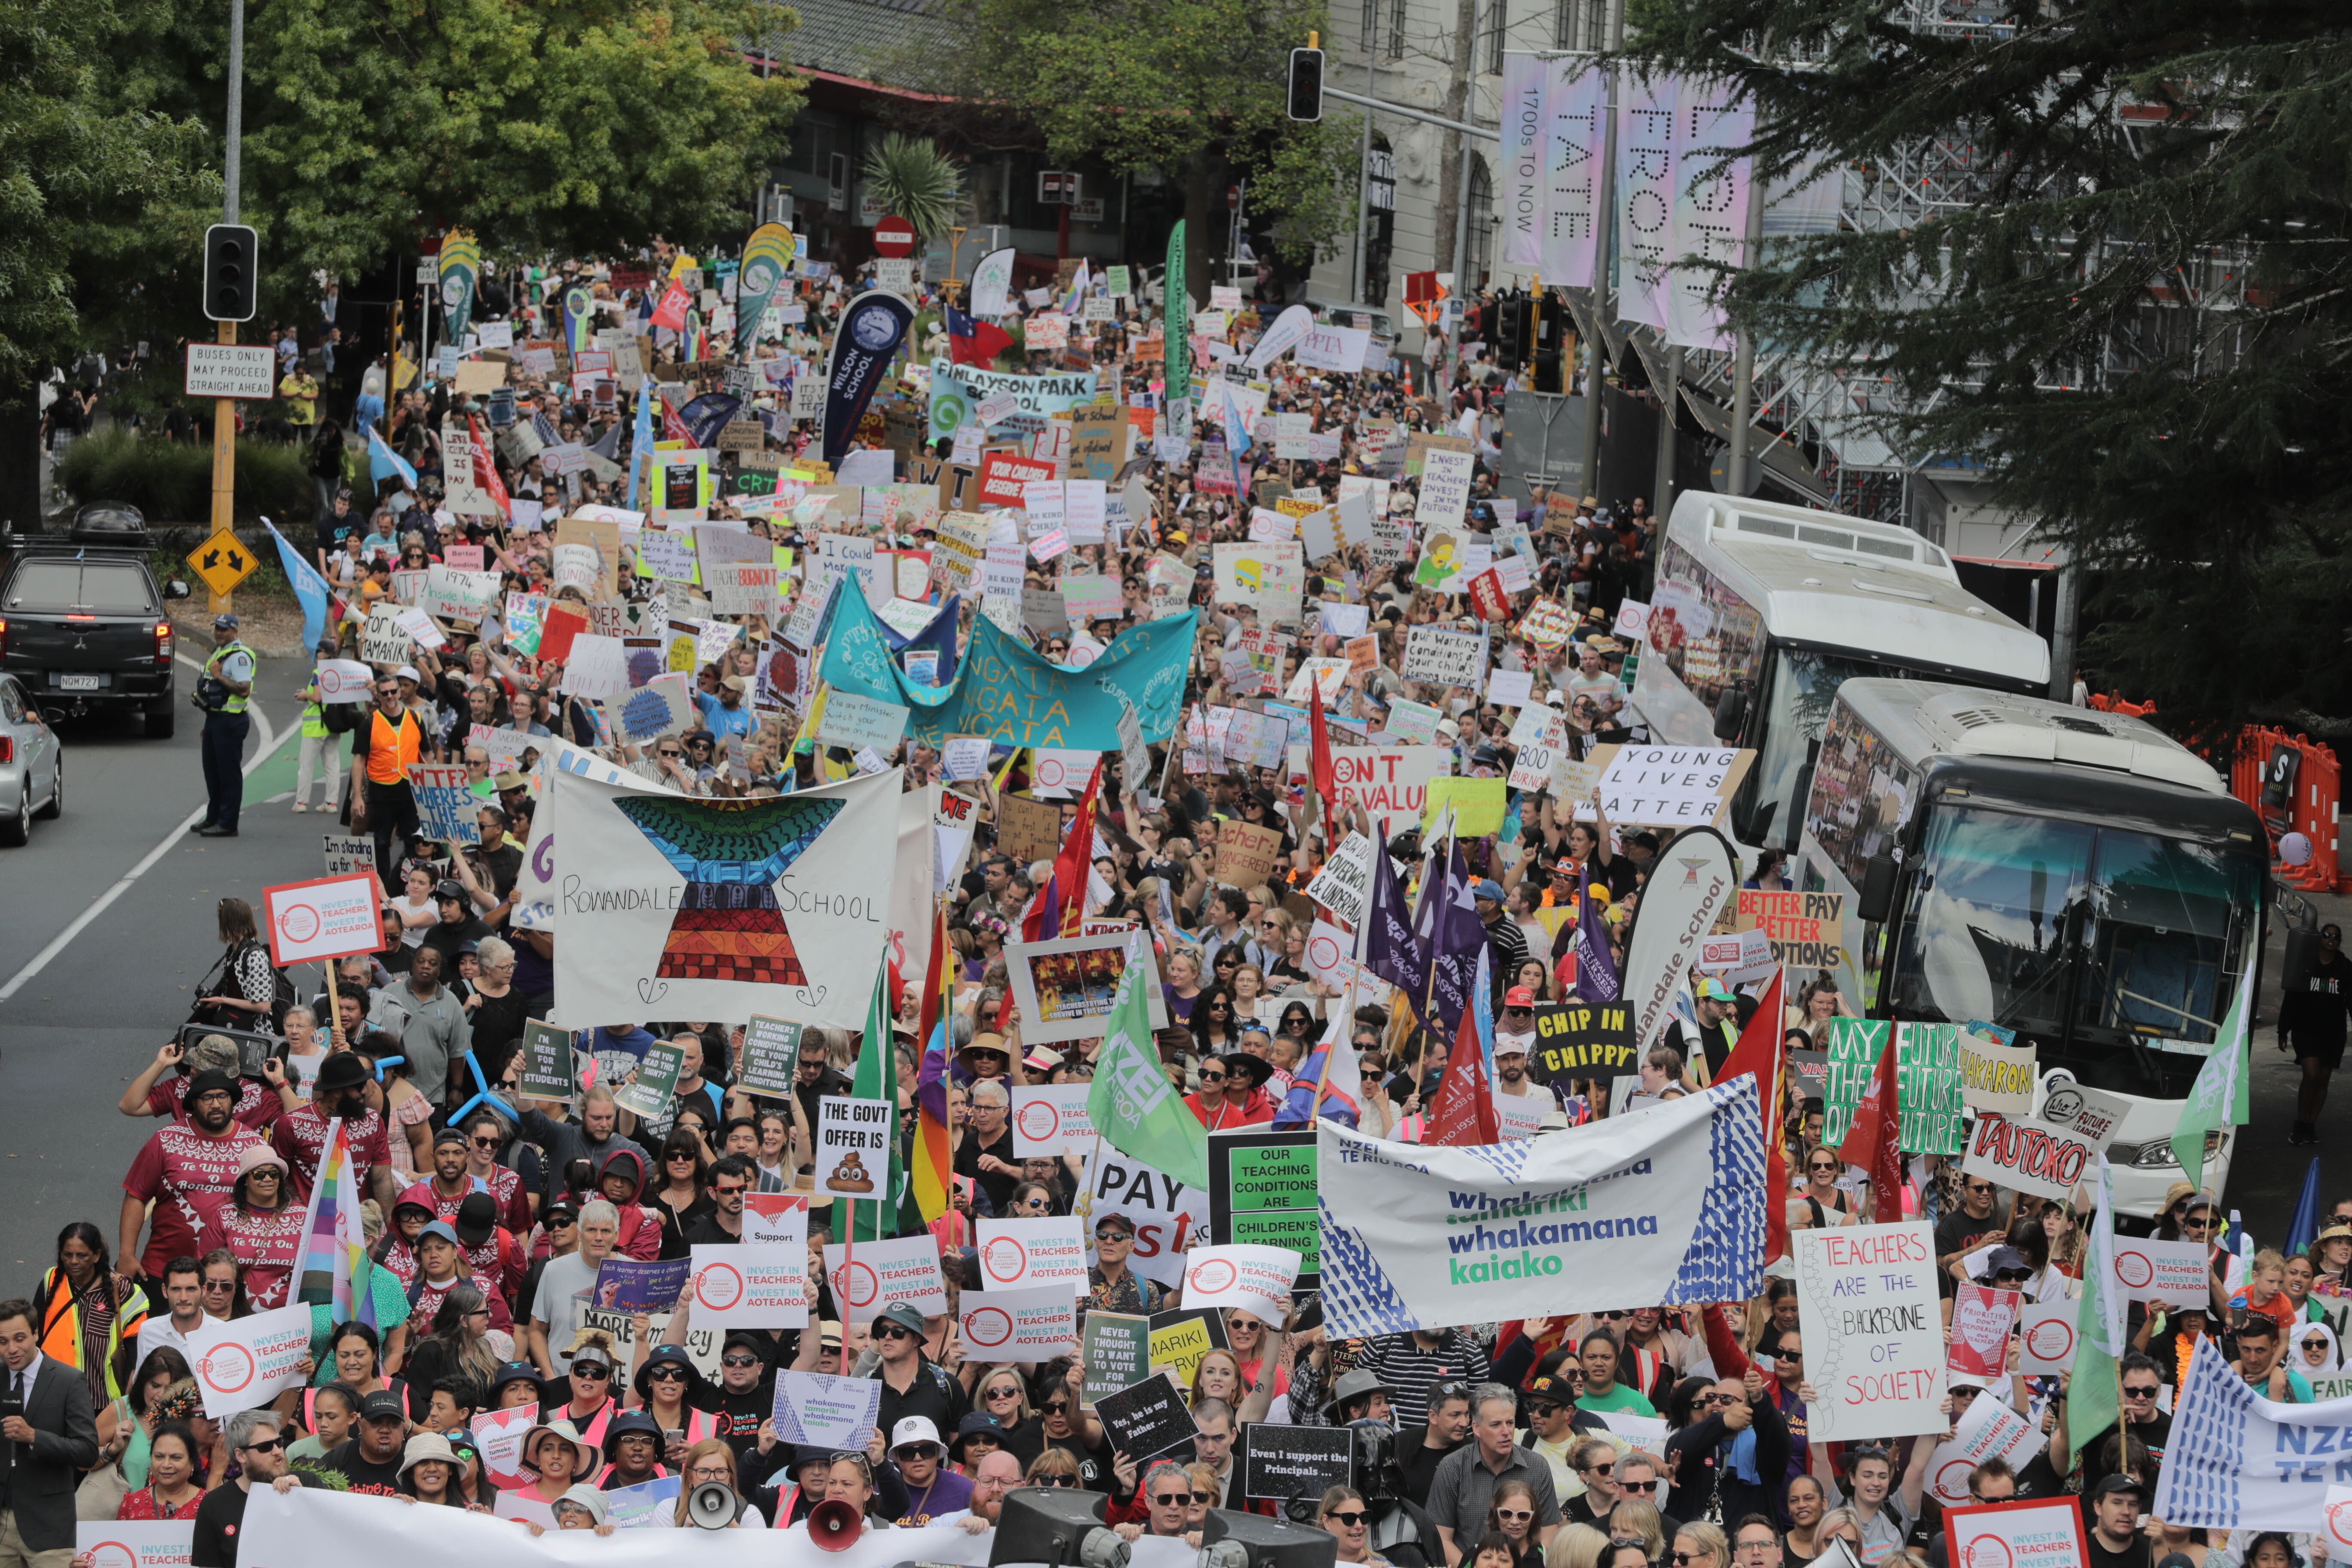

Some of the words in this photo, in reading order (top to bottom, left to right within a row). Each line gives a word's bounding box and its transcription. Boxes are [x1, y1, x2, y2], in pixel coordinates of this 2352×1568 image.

[1521, 88, 1538, 147] 1700s
[1519, 153, 1535, 177] TO
[1554, 105, 1595, 238] TATE
[1516, 184, 1534, 233] NOW
[1305, 333, 1344, 354] PPTA
[197, 349, 231, 360] BUSES
[237, 351, 265, 361] ONLY
[193, 364, 214, 375] MAY
[221, 367, 267, 378] PROCEED
[832, 349, 859, 390] WILSON
[844, 355, 873, 400] SCHOOL
[938, 363, 1034, 394] FINLAYSON
[1038, 378, 1086, 395] PARK
[190, 381, 234, 392] STRAIGHT
[239, 382, 270, 393] AHEAD
[1430, 454, 1467, 465] INVEST
[1427, 473, 1467, 486] TEACHERS
[1424, 485, 1459, 495] INVEST
[1421, 502, 1454, 513] FUTURE
[452, 548, 476, 556] Better
[989, 546, 1021, 554] SUPPORT
[989, 557, 1025, 566] TEACHERS
[446, 571, 474, 589] 1974
[441, 603, 456, 612] No
[1412, 632, 1431, 642] Our
[1435, 634, 1479, 652] Working
[1407, 657, 1433, 668] your
[62, 676, 97, 688] NQM727
[828, 693, 843, 706] Kia
[824, 709, 853, 721] Switch
[856, 717, 876, 726] your
[824, 720, 850, 735] taringa
[1626, 750, 1732, 766] YOUNG
[409, 769, 468, 787] WTF?
[1611, 770, 1721, 788] LIVES
[2269, 782, 2283, 792] SAVORY
[412, 787, 472, 806] WHERE'S
[1580, 798, 1717, 817] MATTER
[428, 806, 457, 824] THE
[325, 836, 339, 853] I'm
[342, 840, 372, 859] standing
[329, 863, 339, 873] up
[340, 861, 351, 872] for
[354, 860, 374, 872] them
[322, 899, 352, 910] INVEST
[564, 875, 681, 915] ROWANDALE
[781, 875, 880, 922] SCHOOL
[322, 905, 368, 917] TEACHERS
[1680, 875, 1724, 948] School
[1738, 894, 1800, 916] BETTER
[1806, 895, 1842, 922] PAY
[323, 918, 355, 928] INVEST
[1756, 916, 1820, 941] BETTER
[325, 924, 374, 936] AOTEAROA
[1056, 1001, 1087, 1010] TEACHERS
[1087, 998, 1108, 1007] TRYING
[755, 1020, 794, 1034] TEACHERS
[1538, 1013, 1590, 1038] CHIP
[1601, 1008, 1625, 1032] IN
[539, 1034, 549, 1043] I'M
[756, 1030, 789, 1042] WORKING
[534, 1044, 556, 1055] HERE
[748, 1038, 794, 1053] CONIDITIONS
[537, 1055, 554, 1064] FOR
[750, 1048, 766, 1057] ARE
[769, 1051, 788, 1061] YOUR
[540, 1065, 552, 1074] MY
[753, 1058, 782, 1069] CHILD'S
[748, 1066, 785, 1079] LEARNING
[524, 1074, 568, 1087] STUDENTS
[744, 1075, 787, 1089] CONDITIONS
[824, 1102, 849, 1120] THE
[851, 1105, 888, 1123] GOVT
[2049, 1098, 2079, 1114] Who?
[2077, 1112, 2112, 1132] FUTURE
[825, 1129, 867, 1147] OFFER
[870, 1133, 883, 1148] IS
[2073, 1124, 2102, 1140] LEADERS
[1339, 1139, 1378, 1156] NZEI
[1976, 1112, 2086, 1187] TAUTOKO
[1261, 1150, 1290, 1161] OUR
[1340, 1150, 1359, 1163] TE
[1363, 1153, 1389, 1166] RIU
[1393, 1161, 1430, 1175] ROA
[1242, 1164, 1310, 1177] TEACHING
[1097, 1163, 1185, 1213] PAY
[1234, 1179, 1318, 1193] CONDITIONS
[1263, 1197, 1290, 1207] ARE
[1237, 1221, 1317, 1234] CHILDREN'S
[754, 1232, 793, 1243] Support
[1448, 1215, 1658, 1254] whakamana
[1028, 1238, 1063, 1247] INVEST
[1066, 1237, 1076, 1246] IN
[1028, 1246, 1080, 1256] TEACHERS
[1819, 1233, 1927, 1267] TEACHERS
[1030, 1260, 1065, 1268] INVEST
[1450, 1250, 1563, 1285] kaiako
[1031, 1268, 1087, 1278] AOTEAROA
[1834, 1276, 1867, 1297] ARE
[1880, 1274, 1917, 1290] THE
[1844, 1304, 1926, 1335] BACKBONE
[1964, 1308, 2007, 1320] PRIORITISE
[1100, 1327, 1130, 1338] NEVER
[1963, 1323, 2003, 1334] DEMORALISE
[1094, 1337, 1136, 1351] THOUGHT
[1093, 1349, 1105, 1359] I'D
[1107, 1351, 1135, 1361] WANT
[1871, 1342, 1902, 1363] OF
[1094, 1361, 1106, 1370] TO
[1110, 1361, 1136, 1372] VOTE
[1106, 1372, 1124, 1381] FOR
[1844, 1367, 1937, 1405] SOCIETY
[805, 1399, 856, 1410] whakamana
[805, 1406, 839, 1415] tamariki
[804, 1412, 854, 1424] whakamana
[1112, 1420, 1130, 1428] Yes,
[1131, 1412, 1143, 1420] he
[1154, 1399, 1167, 1410] my
[803, 1419, 830, 1428] kaiako
[1127, 1421, 1155, 1439] Father
[1963, 1421, 1991, 1454] INVEST
[1990, 1410, 2001, 1421] IN
[1970, 1413, 2010, 1458] TEACHERS
[488, 1439, 513, 1449] tamariki
[489, 1447, 511, 1455] tumeke
[490, 1450, 514, 1461] tumuaki
[1250, 1449, 1276, 1460] Even
[1279, 1450, 1285, 1459] I
[1286, 1451, 1327, 1464] support
[1331, 1452, 1348, 1462] the
[1265, 1465, 1318, 1477] Principals
